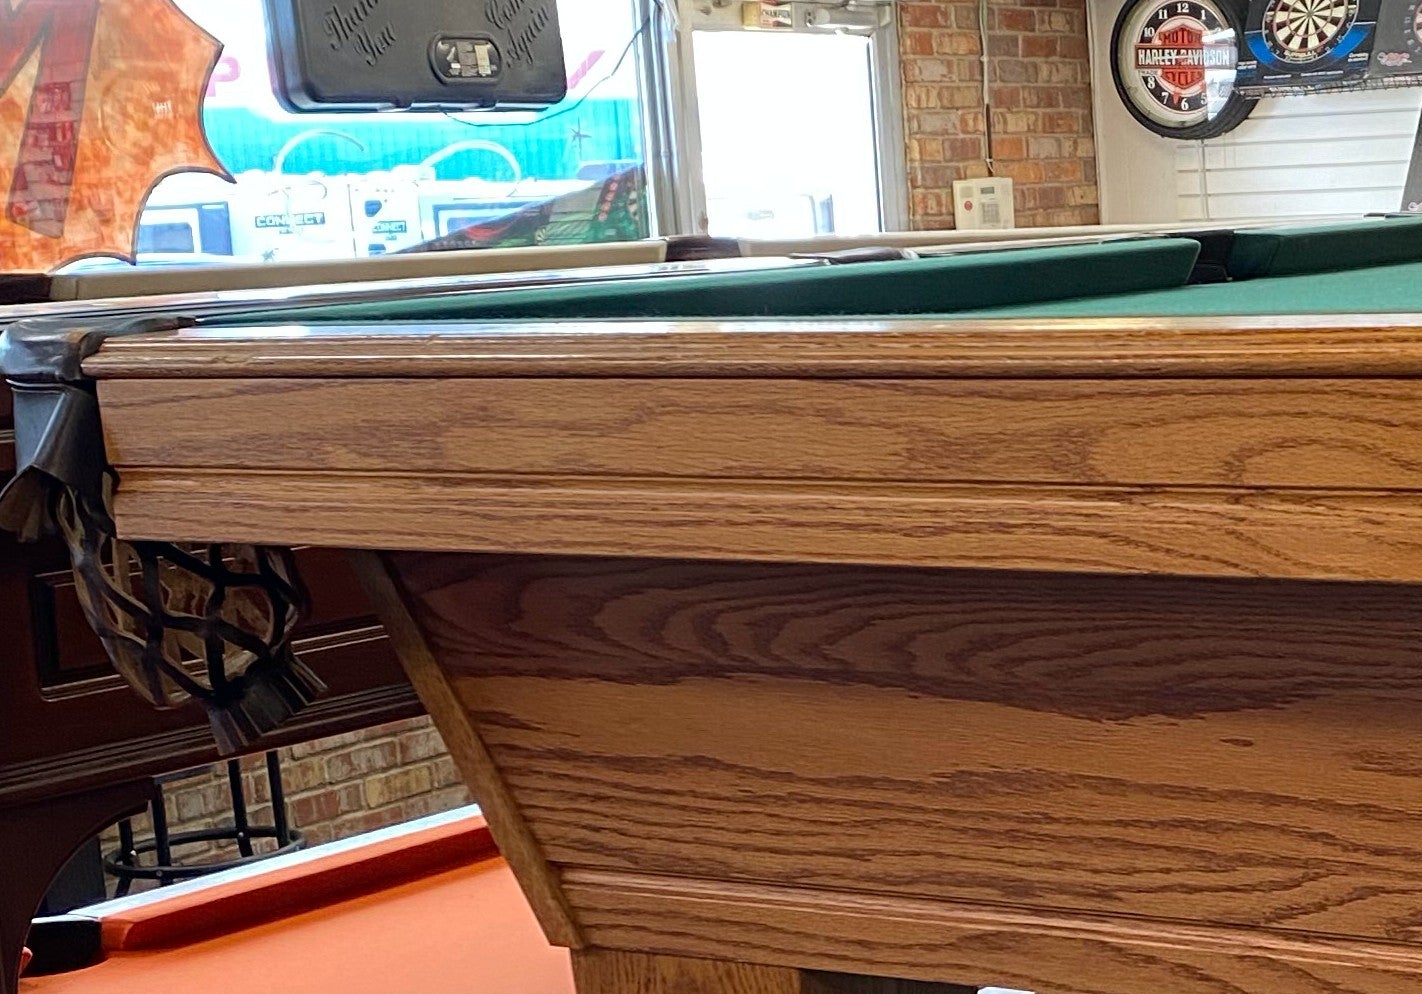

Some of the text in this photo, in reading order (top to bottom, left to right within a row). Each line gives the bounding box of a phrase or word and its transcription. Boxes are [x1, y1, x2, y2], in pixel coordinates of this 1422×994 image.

[1176, 3, 1190, 13] 12
[1158, 9, 1168, 20] 11
[1200, 9, 1207, 20] 1
[1144, 27, 1155, 38] 10
[1147, 76, 1156, 90] 8
[1160, 91, 1170, 105] 7
[1180, 98, 1190, 111] 6
